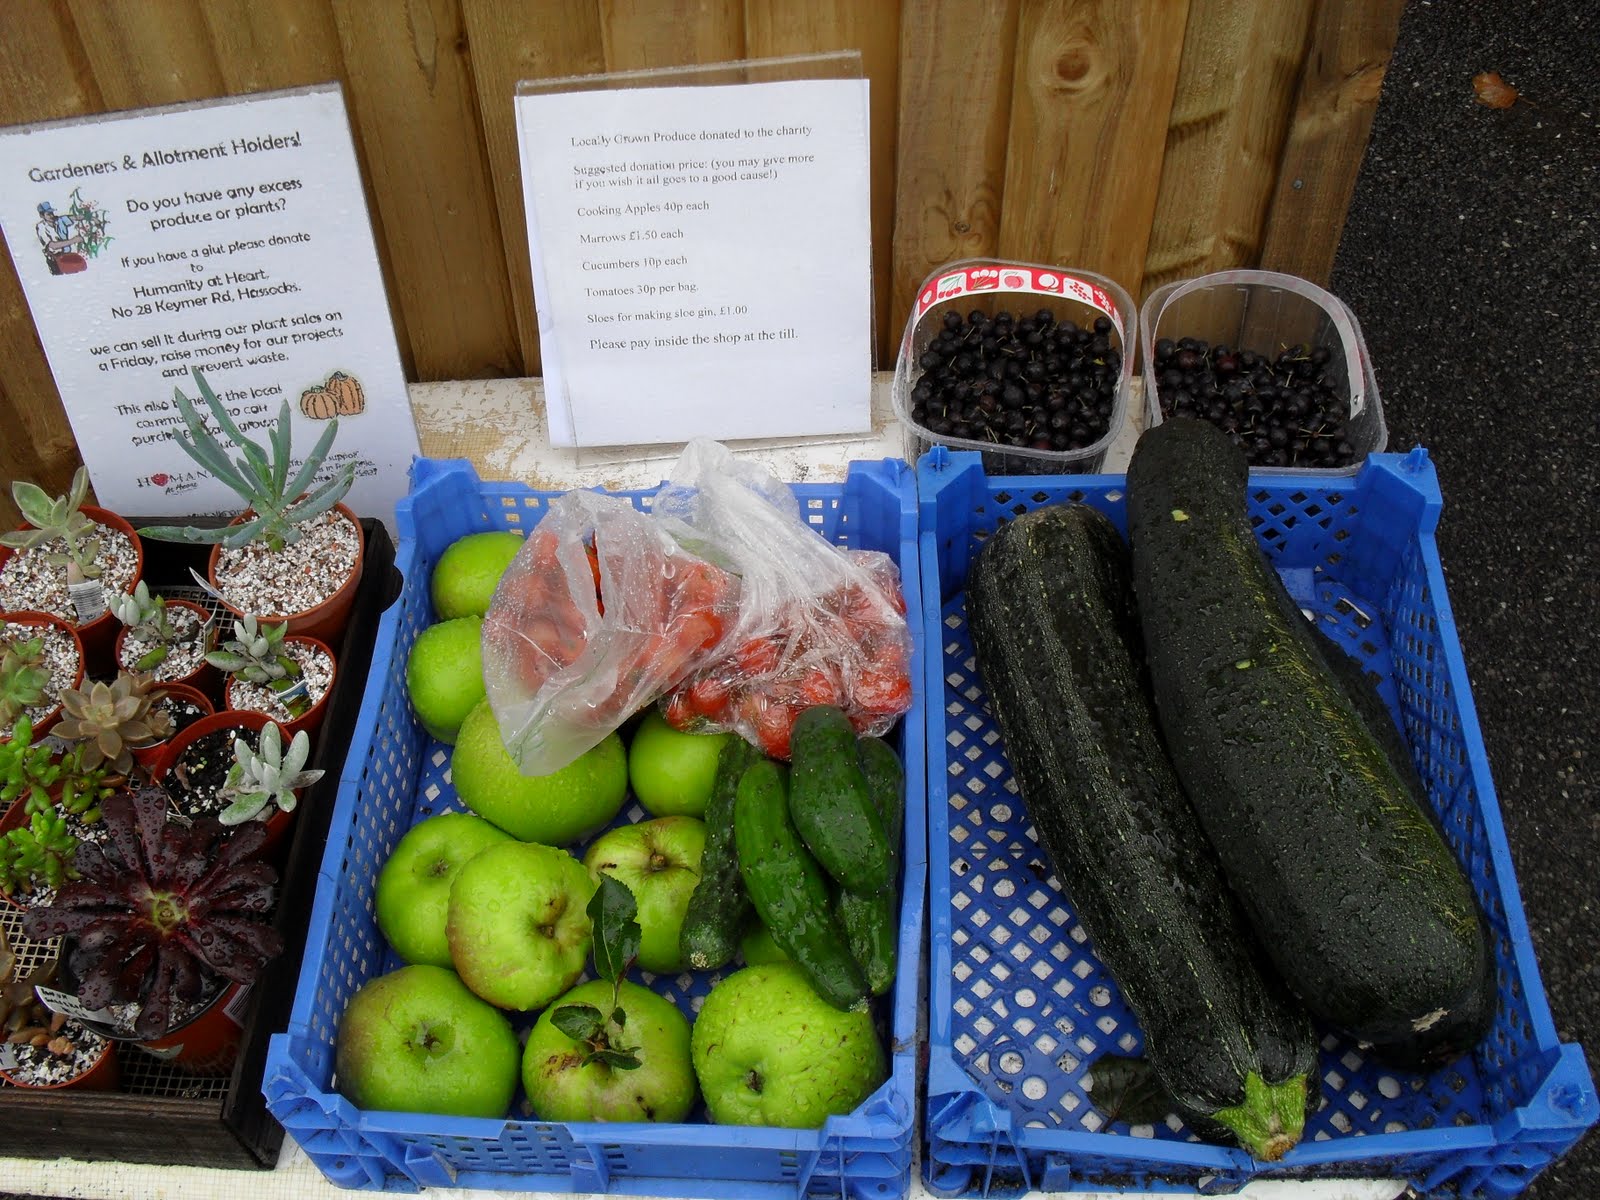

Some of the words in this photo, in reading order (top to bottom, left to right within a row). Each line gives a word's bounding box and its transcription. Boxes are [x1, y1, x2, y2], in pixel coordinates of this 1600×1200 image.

[654, 130, 696, 142] Produce
[700, 128, 740, 140] donated
[744, 128, 754, 138] to
[757, 126, 773, 137] the
[776, 125, 812, 137] charity
[28, 161, 118, 182] Gardeners
[122, 154, 137, 170] &
[142, 142, 227, 168] Allotment
[232, 132, 302, 156] Holders!
[574, 162, 627, 176] Suggested
[630, 160, 675, 172] donation
[678, 158, 708, 171] price:
[711, 156, 735, 170] (you
[738, 156, 759, 168] may
[762, 154, 786, 167] give
[788, 153, 814, 164] more
[575, 178, 584, 189] if
[586, 178, 606, 190] you
[608, 174, 632, 187] wish
[636, 174, 643, 184] it
[663, 174, 686, 186] goes
[689, 172, 700, 182] to
[702, 174, 709, 182] a
[712, 169, 737, 184] good
[740, 168, 778, 181] cause!)
[127, 199, 149, 213] Do
[152, 195, 180, 212] you
[184, 188, 222, 204] have
[226, 187, 254, 202] any
[258, 179, 303, 194] excess
[150, 213, 212, 232] produce
[215, 210, 230, 220] or
[235, 198, 286, 220] plants?
[577, 204, 622, 217] Cooking
[624, 202, 660, 215] Apples
[664, 200, 683, 212] 40p
[686, 199, 710, 210] each
[580, 232, 626, 244] Marrows
[630, 228, 657, 241] £1.50
[660, 228, 684, 239] each
[121, 256, 130, 268] If
[132, 253, 155, 268] you
[157, 248, 188, 262] have
[191, 248, 199, 258] a
[228, 238, 266, 255] please
[268, 232, 310, 246] donate
[191, 262, 204, 273] to
[582, 258, 640, 271] Cucumbers
[644, 256, 662, 268] 10p
[664, 254, 688, 266] each
[133, 279, 204, 298] Humanity
[207, 275, 222, 287] at
[584, 286, 634, 297] Tomatoes
[636, 283, 656, 296] 30p
[659, 282, 676, 293] per
[112, 306, 133, 320] No
[136, 304, 152, 316] 28
[156, 296, 207, 317] Keymer
[587, 311, 614, 324] Sloes
[618, 309, 632, 322] for
[634, 306, 672, 322] making
[674, 304, 695, 318] sloe
[720, 303, 748, 315] £1.00
[113, 340, 138, 353] can
[140, 334, 162, 348] sell
[177, 327, 222, 344] during
[224, 324, 248, 336] our
[251, 318, 288, 336] plant
[290, 312, 322, 326] sales
[326, 310, 342, 322] on
[590, 336, 626, 350] Please
[630, 334, 650, 350] pay
[654, 330, 689, 346] inside
[692, 330, 710, 344] the
[713, 328, 741, 344] shop
[744, 328, 754, 341] at
[758, 326, 776, 340] the
[778, 324, 798, 338] till.
[98, 362, 109, 372] a
[110, 354, 158, 370] Friday,
[161, 349, 192, 362] raise
[194, 342, 240, 360] money
[243, 337, 262, 350] for
[266, 334, 289, 346] our
[292, 328, 344, 348] projects
[162, 366, 188, 379] and
[116, 404, 142, 416] This
[144, 400, 170, 412] also
[225, 389, 248, 402] the
[250, 384, 282, 398] local
